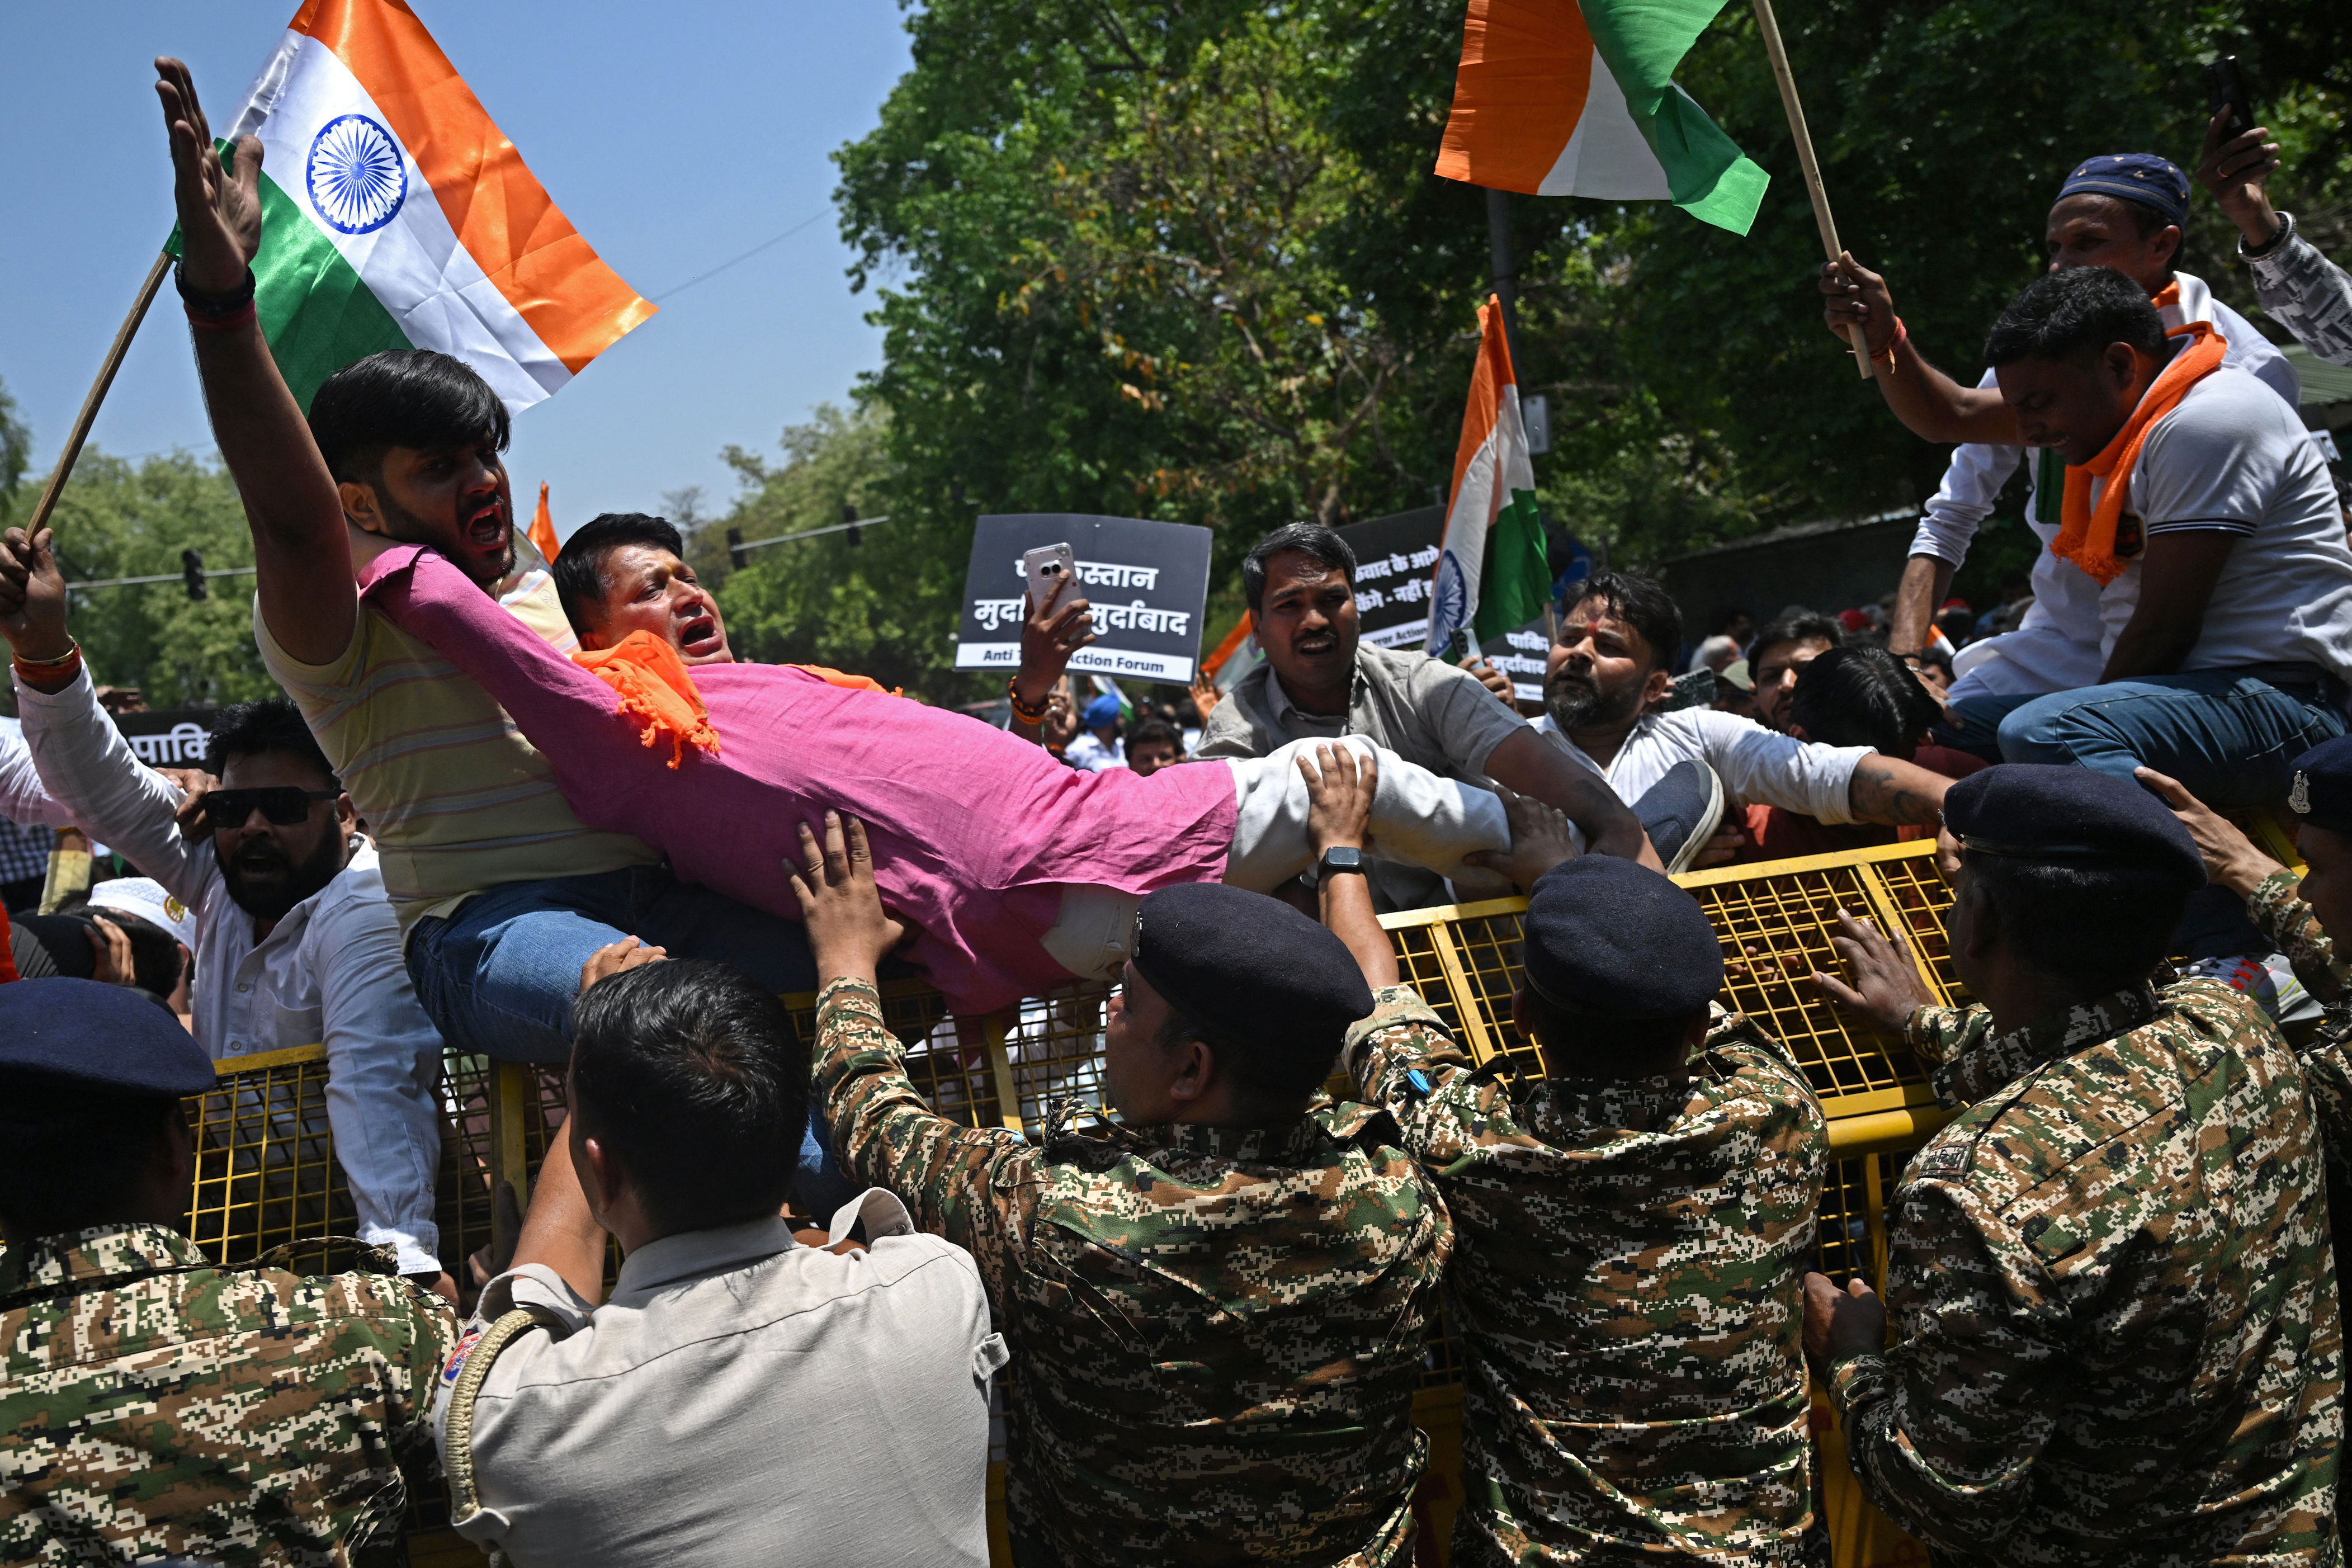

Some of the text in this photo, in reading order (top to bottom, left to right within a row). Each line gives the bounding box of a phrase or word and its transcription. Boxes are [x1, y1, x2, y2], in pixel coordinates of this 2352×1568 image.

[1390, 552, 1409, 572] के
[1084, 599, 1191, 636] मुर्दाबाद
[983, 650, 1013, 661] Anti
[1117, 657, 1164, 673] Forum
